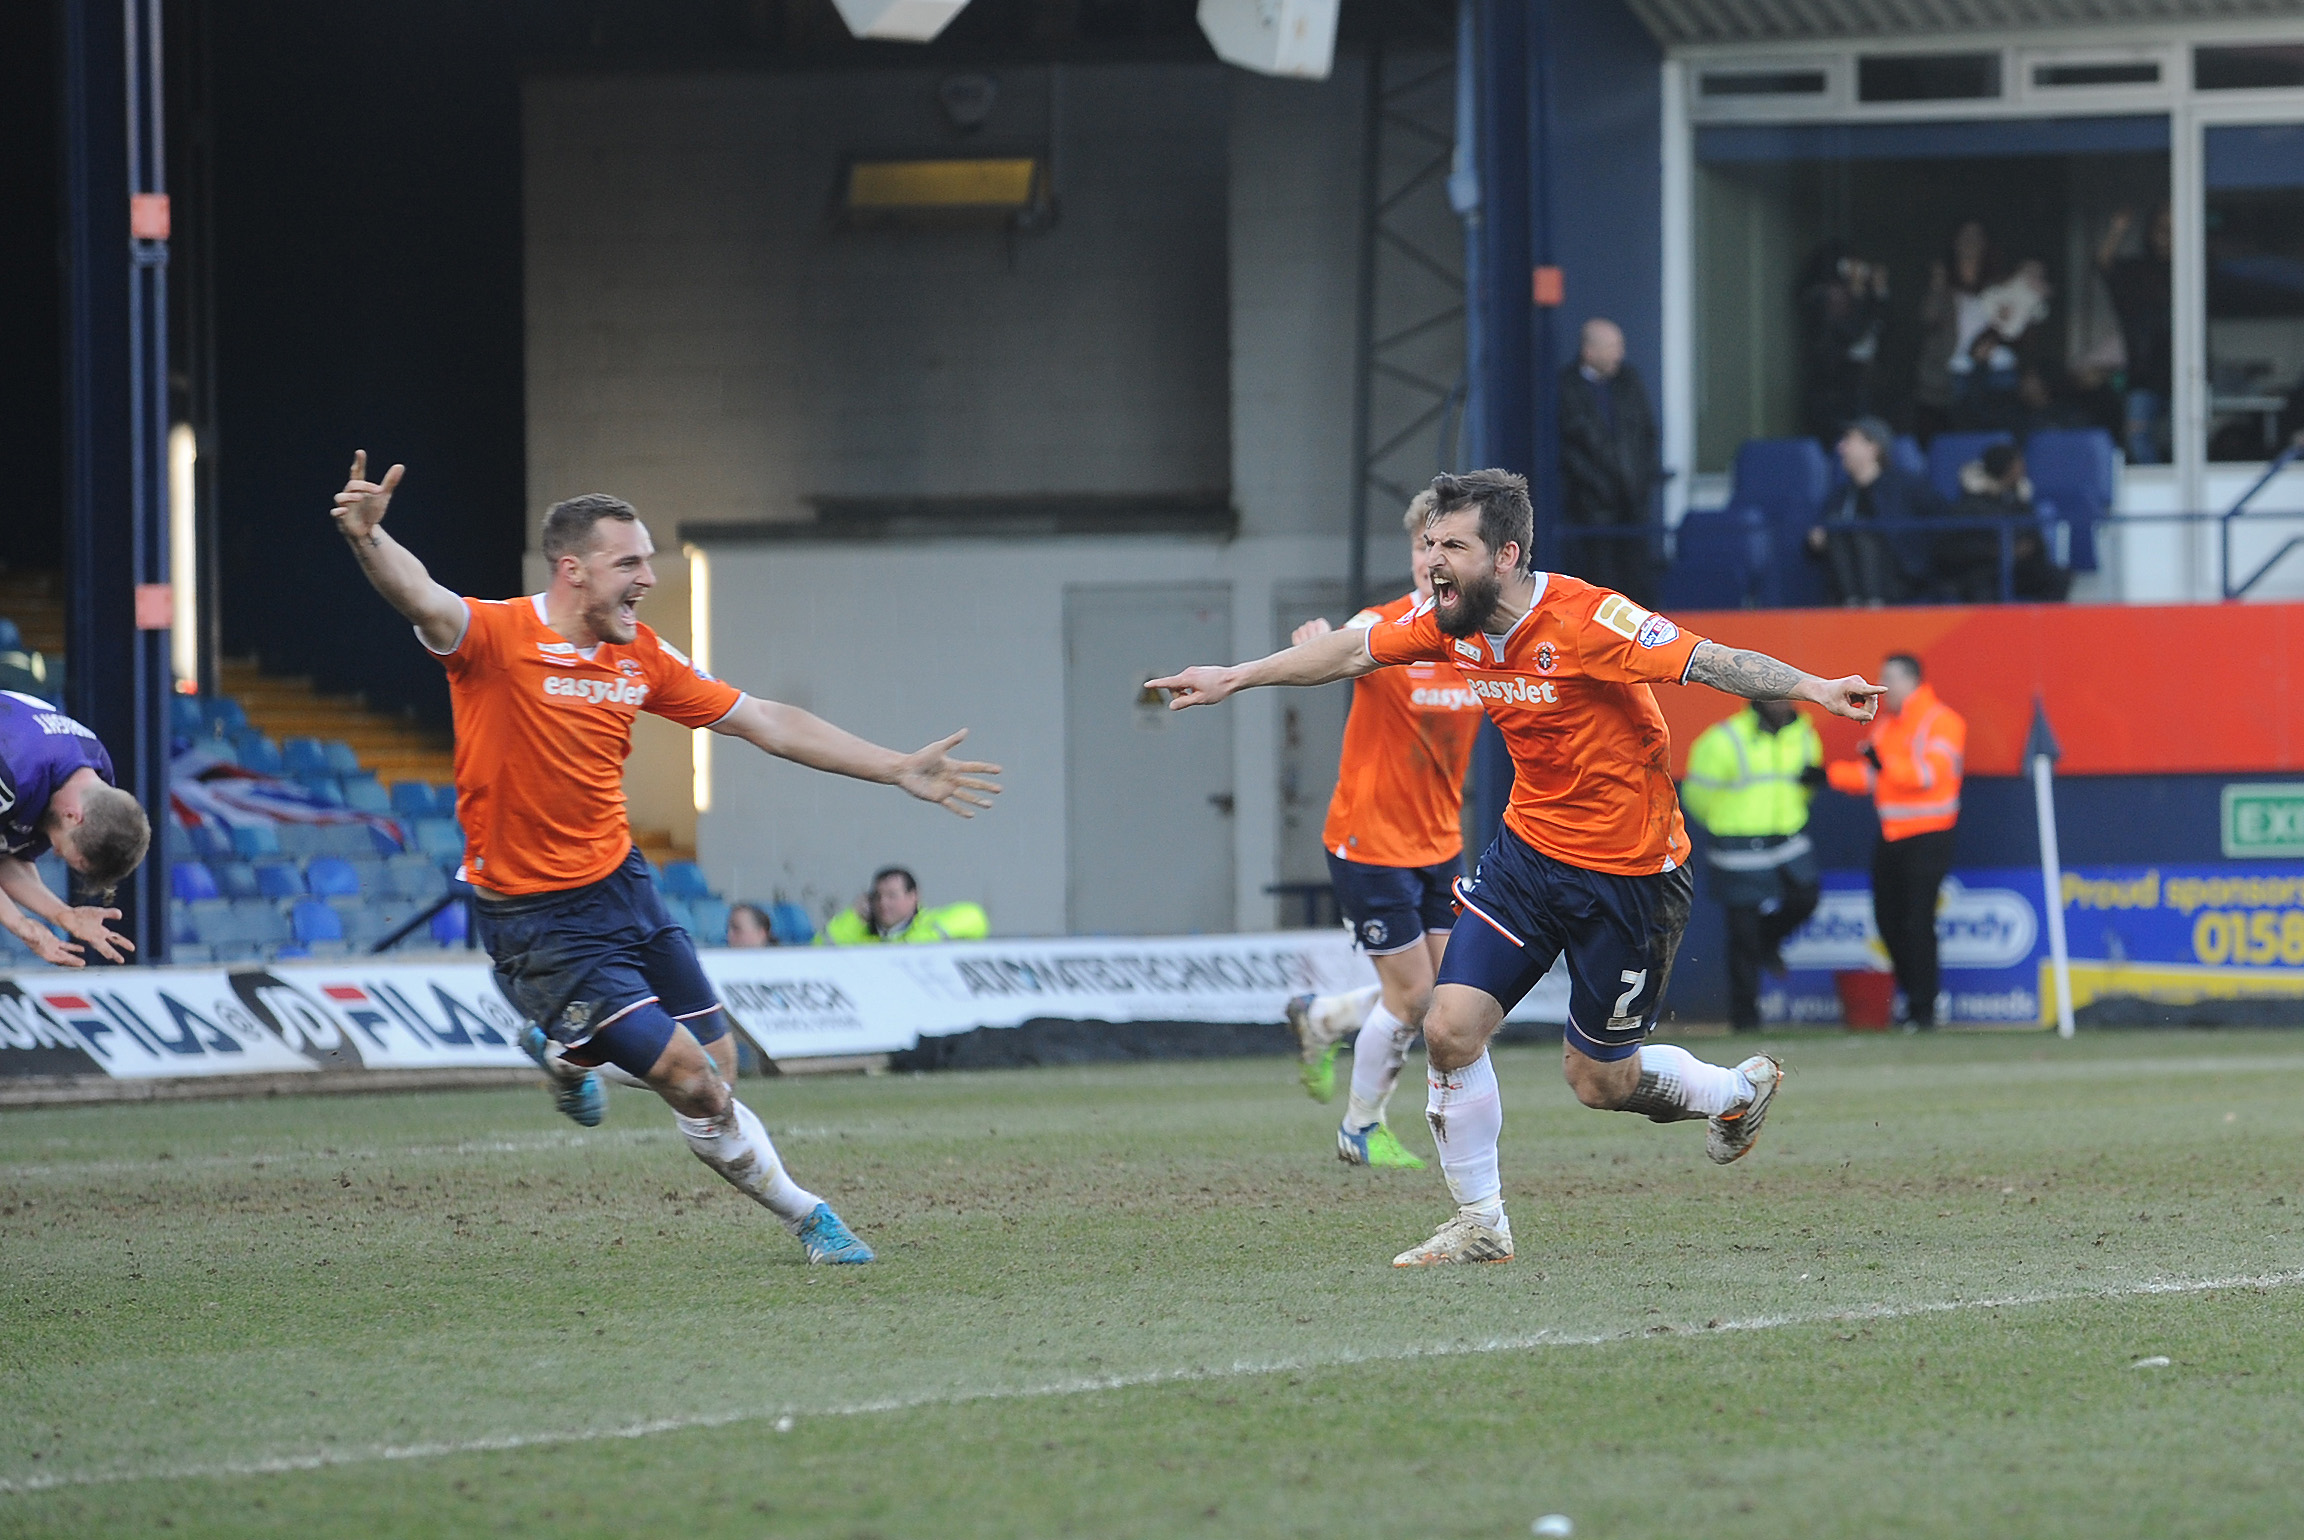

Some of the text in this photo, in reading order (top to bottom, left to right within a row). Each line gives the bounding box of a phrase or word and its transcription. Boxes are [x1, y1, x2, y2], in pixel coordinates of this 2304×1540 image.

[542, 675, 650, 706] easyJet
[2061, 868, 2160, 910] Proud
[2193, 911, 2304, 965] 0158
[320, 981, 508, 1050] FILA
[1612, 968, 1647, 1018] 7
[42, 990, 244, 1058] FILA
